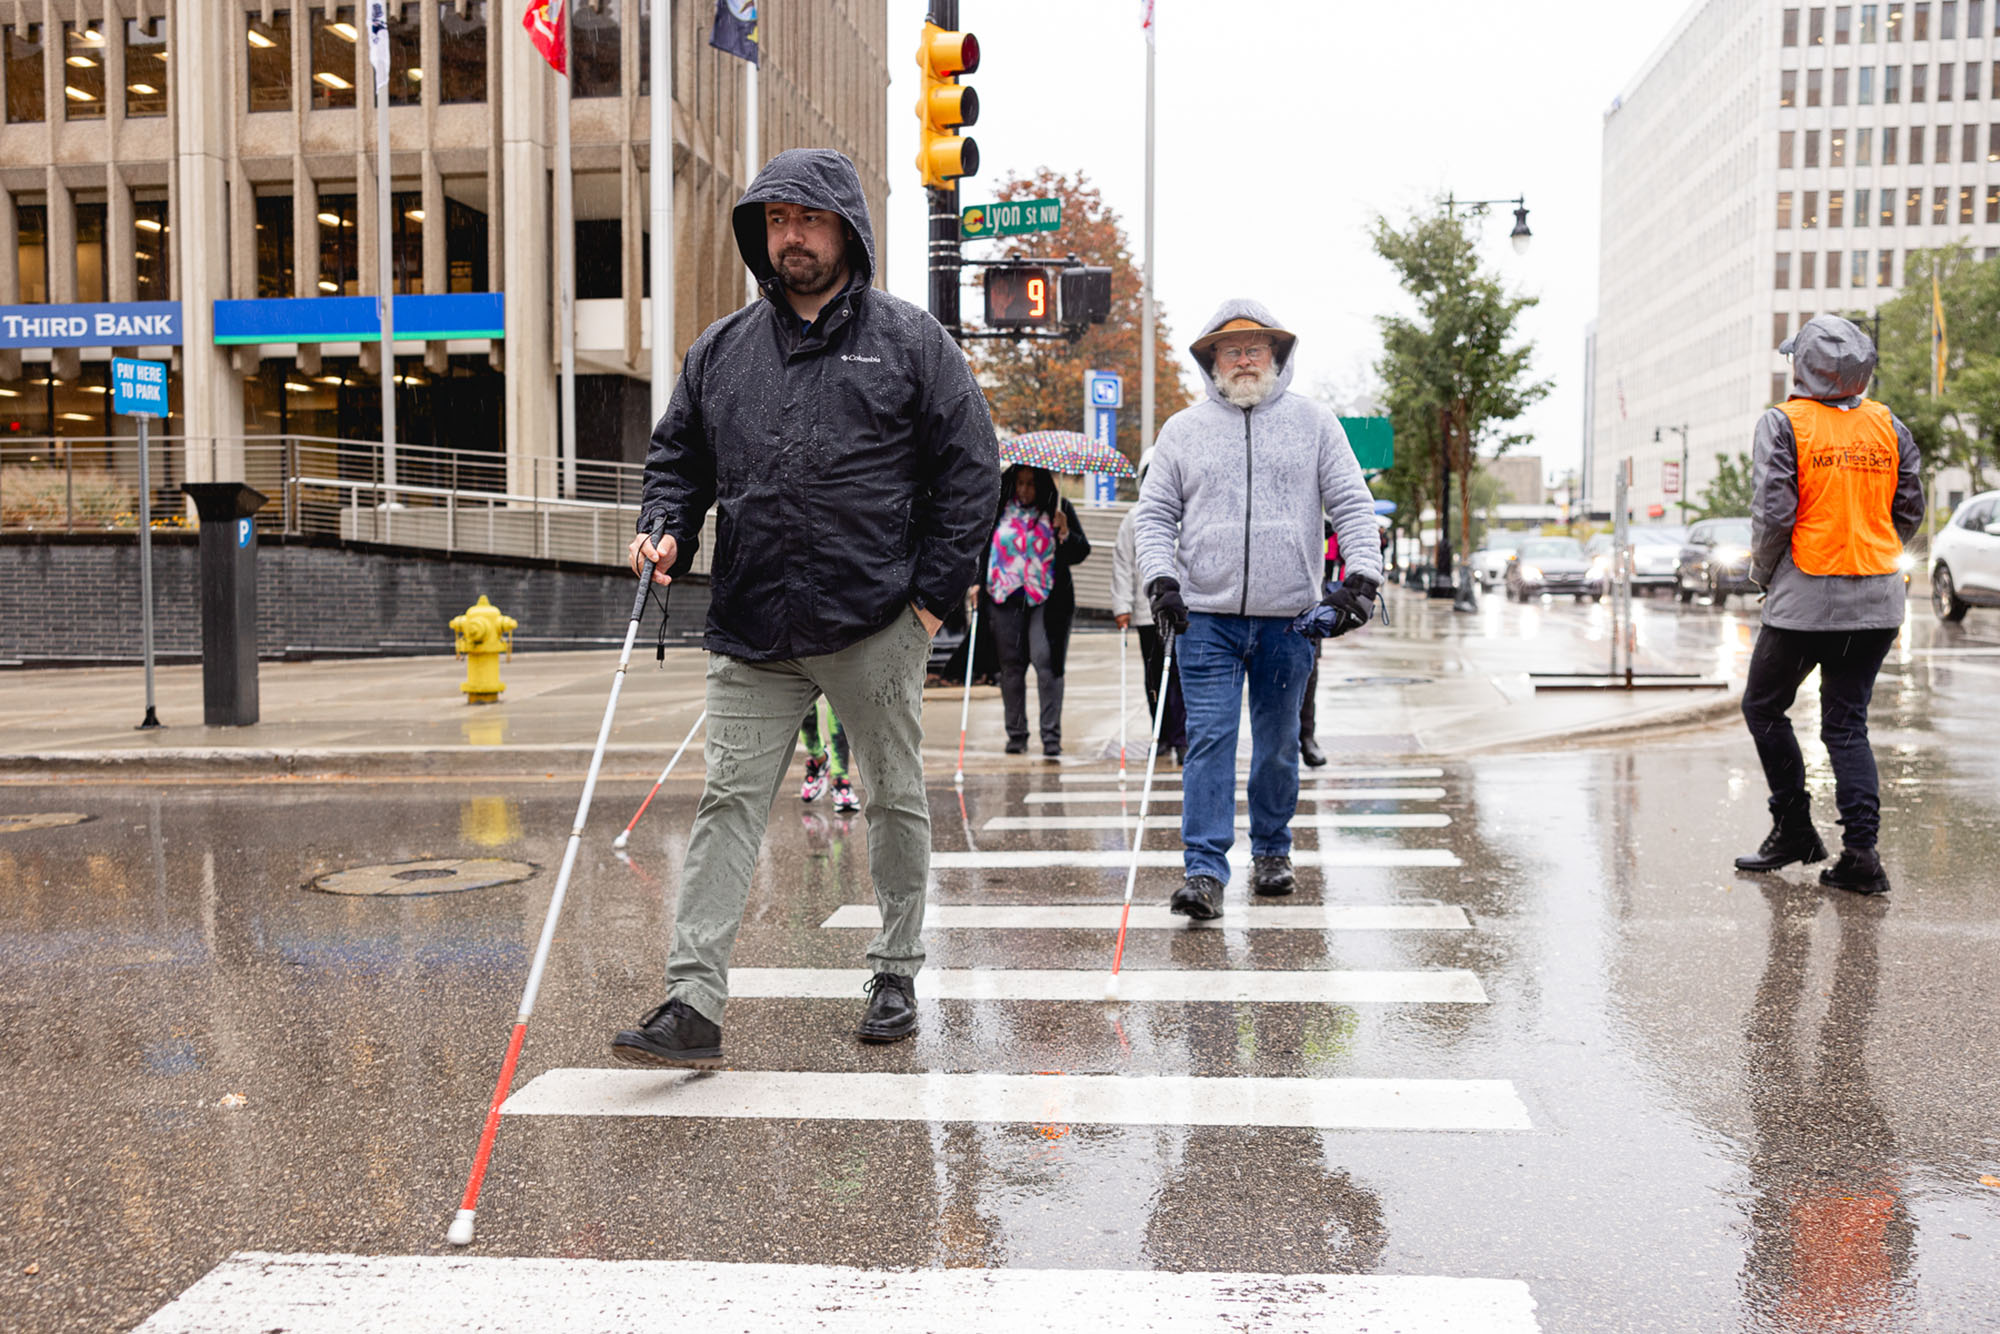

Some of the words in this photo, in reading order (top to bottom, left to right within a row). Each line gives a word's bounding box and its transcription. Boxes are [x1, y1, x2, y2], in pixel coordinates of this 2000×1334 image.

[986, 204, 1021, 234] Lyon
[1025, 206, 1037, 225] St
[1040, 205, 1059, 224] NW
[1027, 278, 1045, 317] 9
[2, 315, 88, 338] THIRD
[94, 313, 174, 336] BANK
[849, 354, 881, 363] Columbia
[117, 362, 135, 380] PAY
[136, 365, 163, 383] HERE
[120, 382, 134, 399] TO
[135, 385, 161, 402] PARK
[1812, 454, 1842, 469] Mary
[1843, 450, 1867, 466] Free
[1869, 453, 1892, 468] Bed
[239, 520, 249, 543] P
